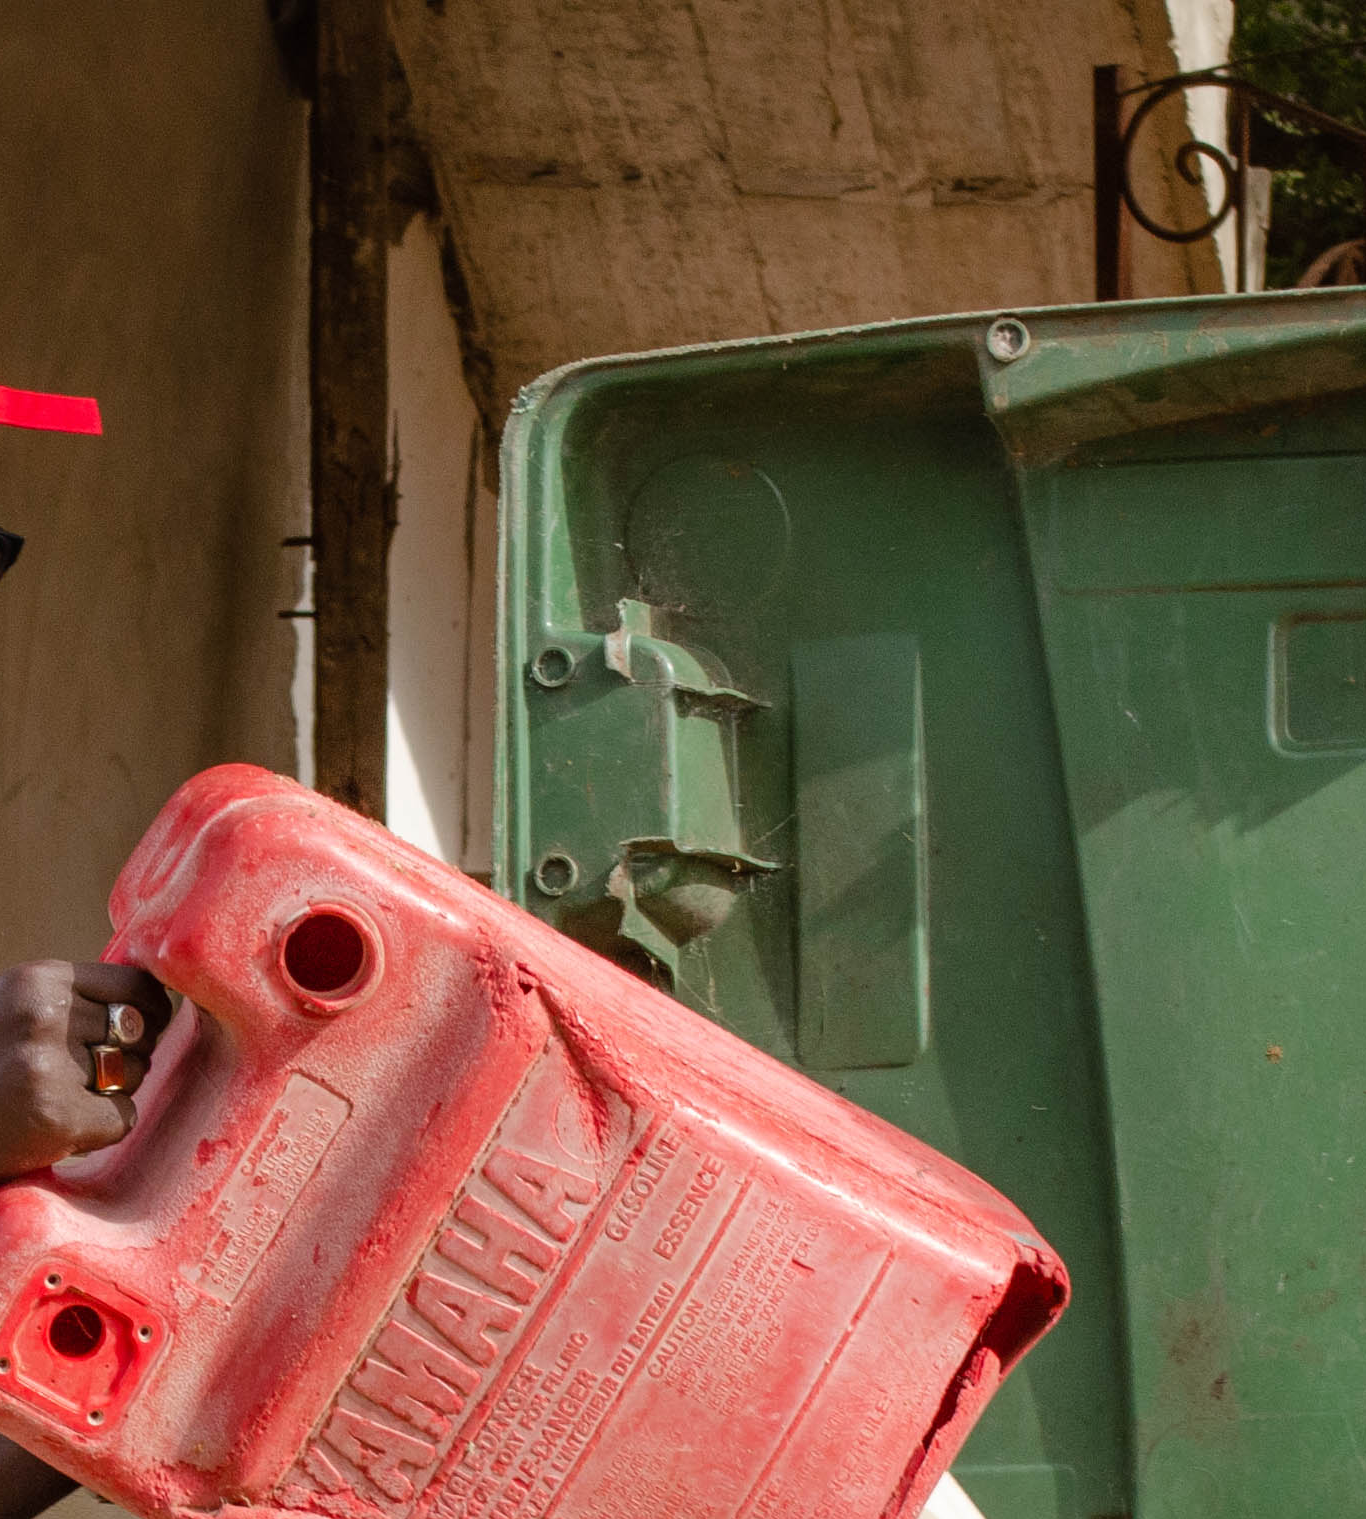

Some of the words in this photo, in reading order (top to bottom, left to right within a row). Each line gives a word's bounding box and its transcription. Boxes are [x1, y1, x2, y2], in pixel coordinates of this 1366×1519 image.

[601, 1127, 685, 1244] GASOLINE
[650, 1154, 728, 1261] ESSENCE
[279, 1148, 597, 1515] YAMAHA
[610, 1346, 636, 1376] DU
[627, 1280, 677, 1349] BATEAU
[646, 1298, 704, 1380] CAUTION
[702, 1279, 734, 1320] CLOSED
[539, 1328, 590, 1395] FILLING
